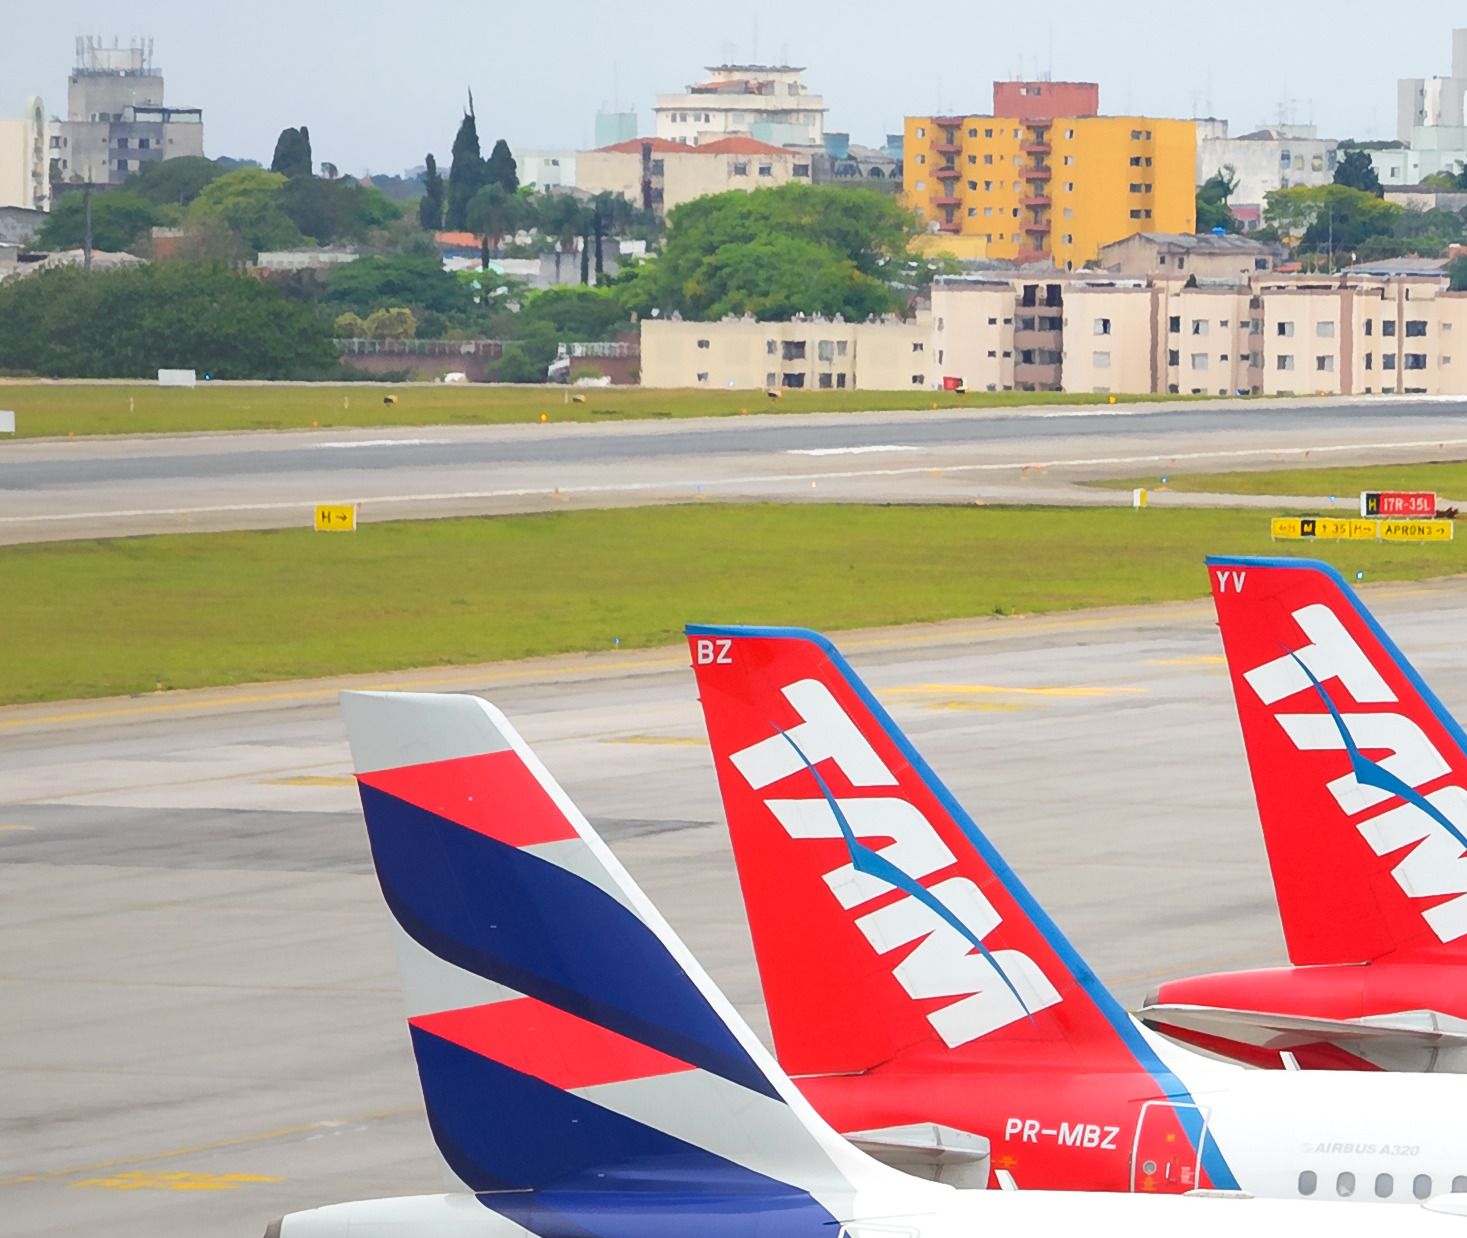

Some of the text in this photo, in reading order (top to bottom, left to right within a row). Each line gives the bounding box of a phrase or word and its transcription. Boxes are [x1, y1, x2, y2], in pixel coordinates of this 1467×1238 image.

[321, 510, 332, 524] H
[1383, 500, 1431, 511] 17R-35L
[1216, 570, 1247, 593] YV
[697, 639, 733, 665] BZ
[728, 678, 1064, 1049] TAM
[1004, 1117, 1121, 1150] PR-MBZ
[1314, 1142, 1420, 1157] AIRBUS A320
